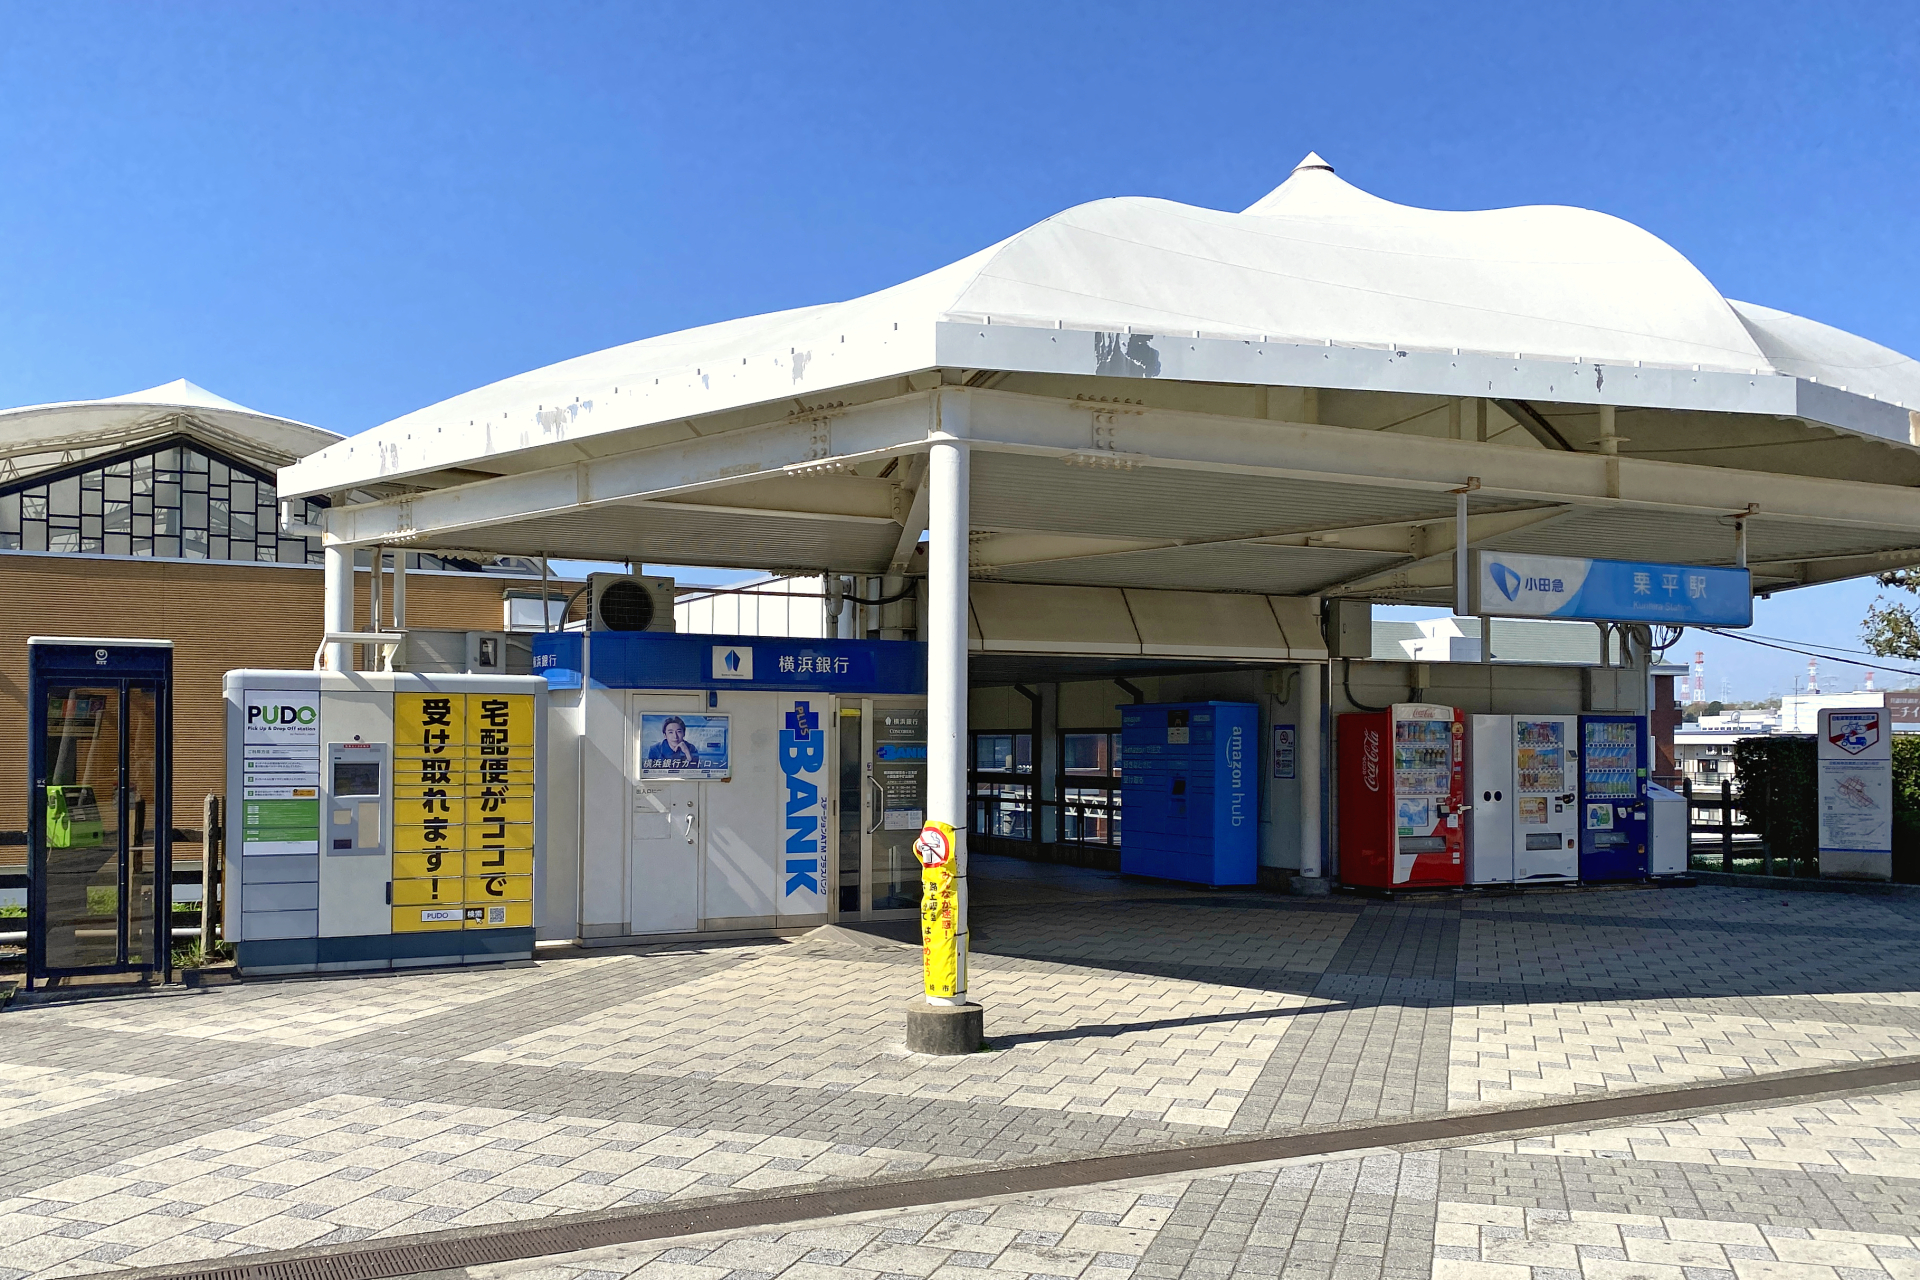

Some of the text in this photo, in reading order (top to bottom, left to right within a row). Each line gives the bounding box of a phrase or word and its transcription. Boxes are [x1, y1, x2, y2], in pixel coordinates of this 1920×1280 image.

[1525, 577, 1564, 593] 小田急
[1633, 571, 1707, 599] 栗平駅
[778, 655, 850, 673] 横浜銀行
[247, 705, 317, 725] PUDO
[643, 758, 727, 769] 横浜銀行カードローン
[1363, 727, 1379, 792] Coca-Cola
[1231, 726, 1245, 827] amazon hub
[421, 698, 451, 900] 受け取れます！
[479, 699, 509, 897] 宅配便がココで
[779, 706, 825, 898] PLUS BANK
[426, 911, 449, 920] PUDO
